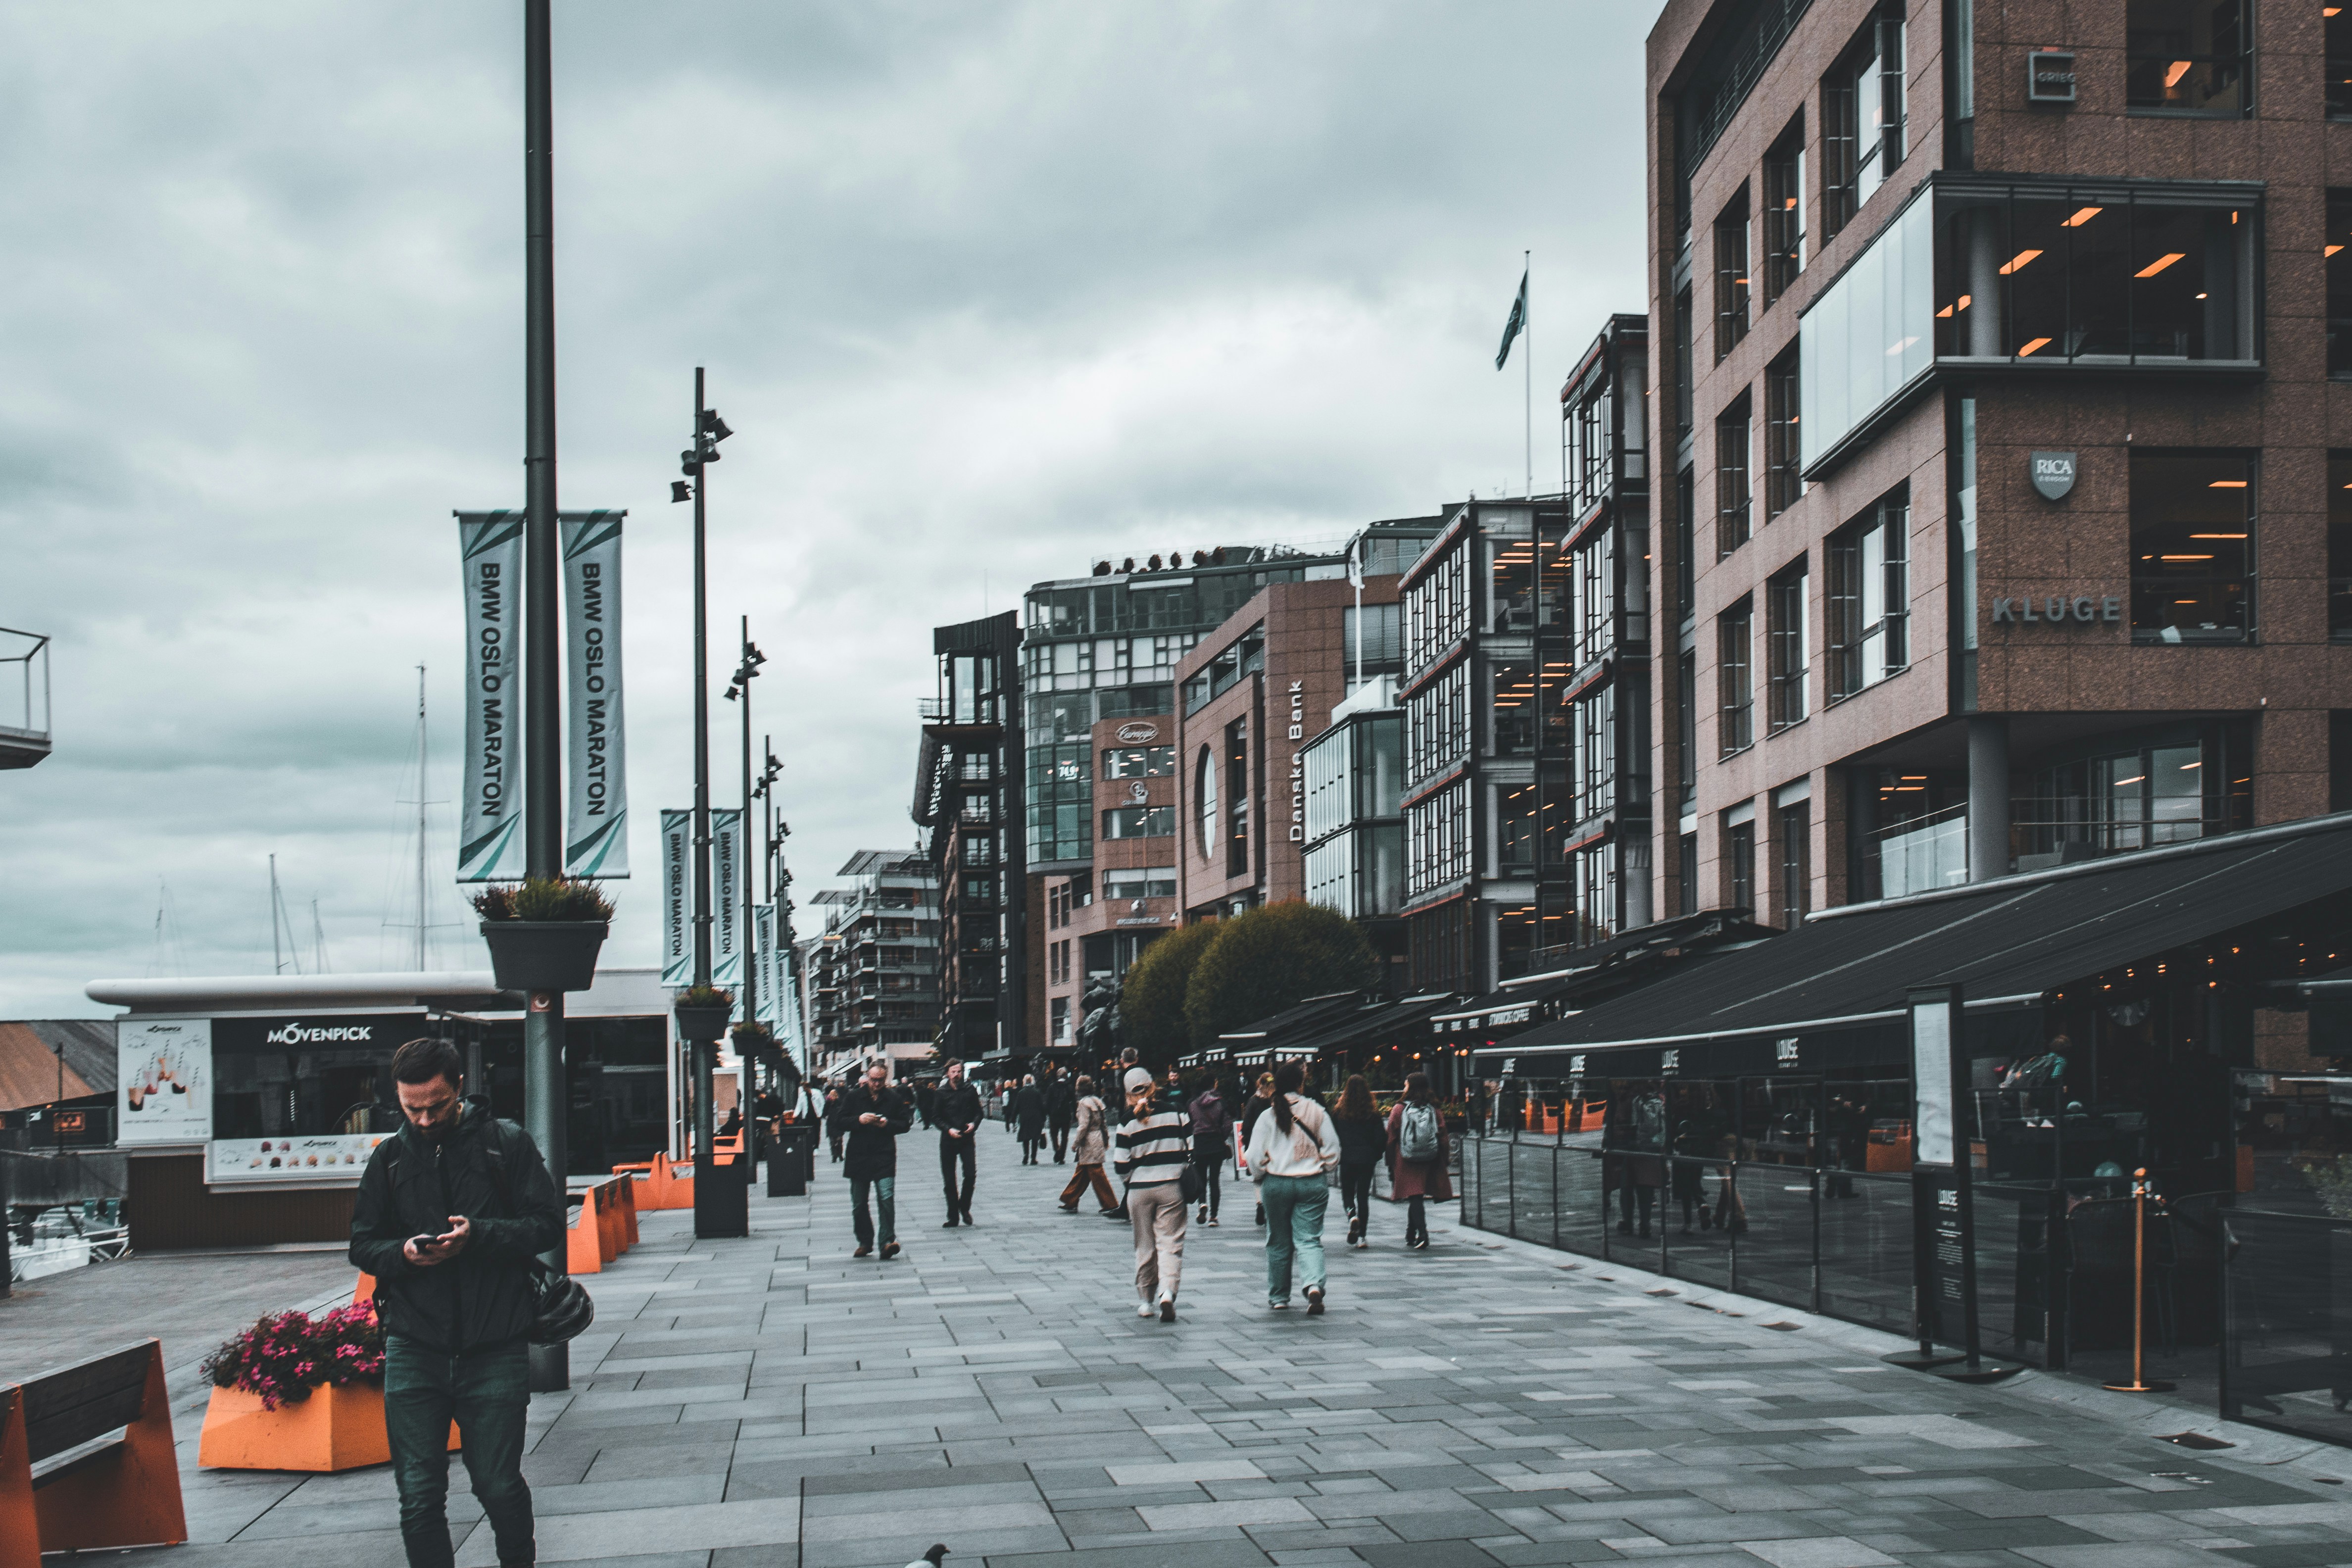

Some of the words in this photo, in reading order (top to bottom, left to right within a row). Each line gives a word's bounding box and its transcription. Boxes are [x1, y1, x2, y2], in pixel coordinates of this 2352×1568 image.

[2036, 459, 2072, 474] RICA
[481, 562, 501, 621] BMW
[582, 562, 602, 622] BMW
[1992, 596, 2121, 622] KLUGE
[481, 627, 501, 693] OSLO
[585, 627, 604, 693] OSLO
[1288, 680, 1303, 739] Bank
[482, 698, 502, 817] MARATON
[586, 699, 605, 816] MARATON
[1289, 751, 1303, 842] Danske
[670, 833, 682, 863] BMW
[720, 832, 731, 861] BMW
[671, 865, 682, 897] OSLO
[721, 863, 731, 895] OSLO
[671, 899, 682, 956] MARATON
[722, 897, 731, 954] MARATON
[1776, 1037, 1799, 1060] LOUISE
